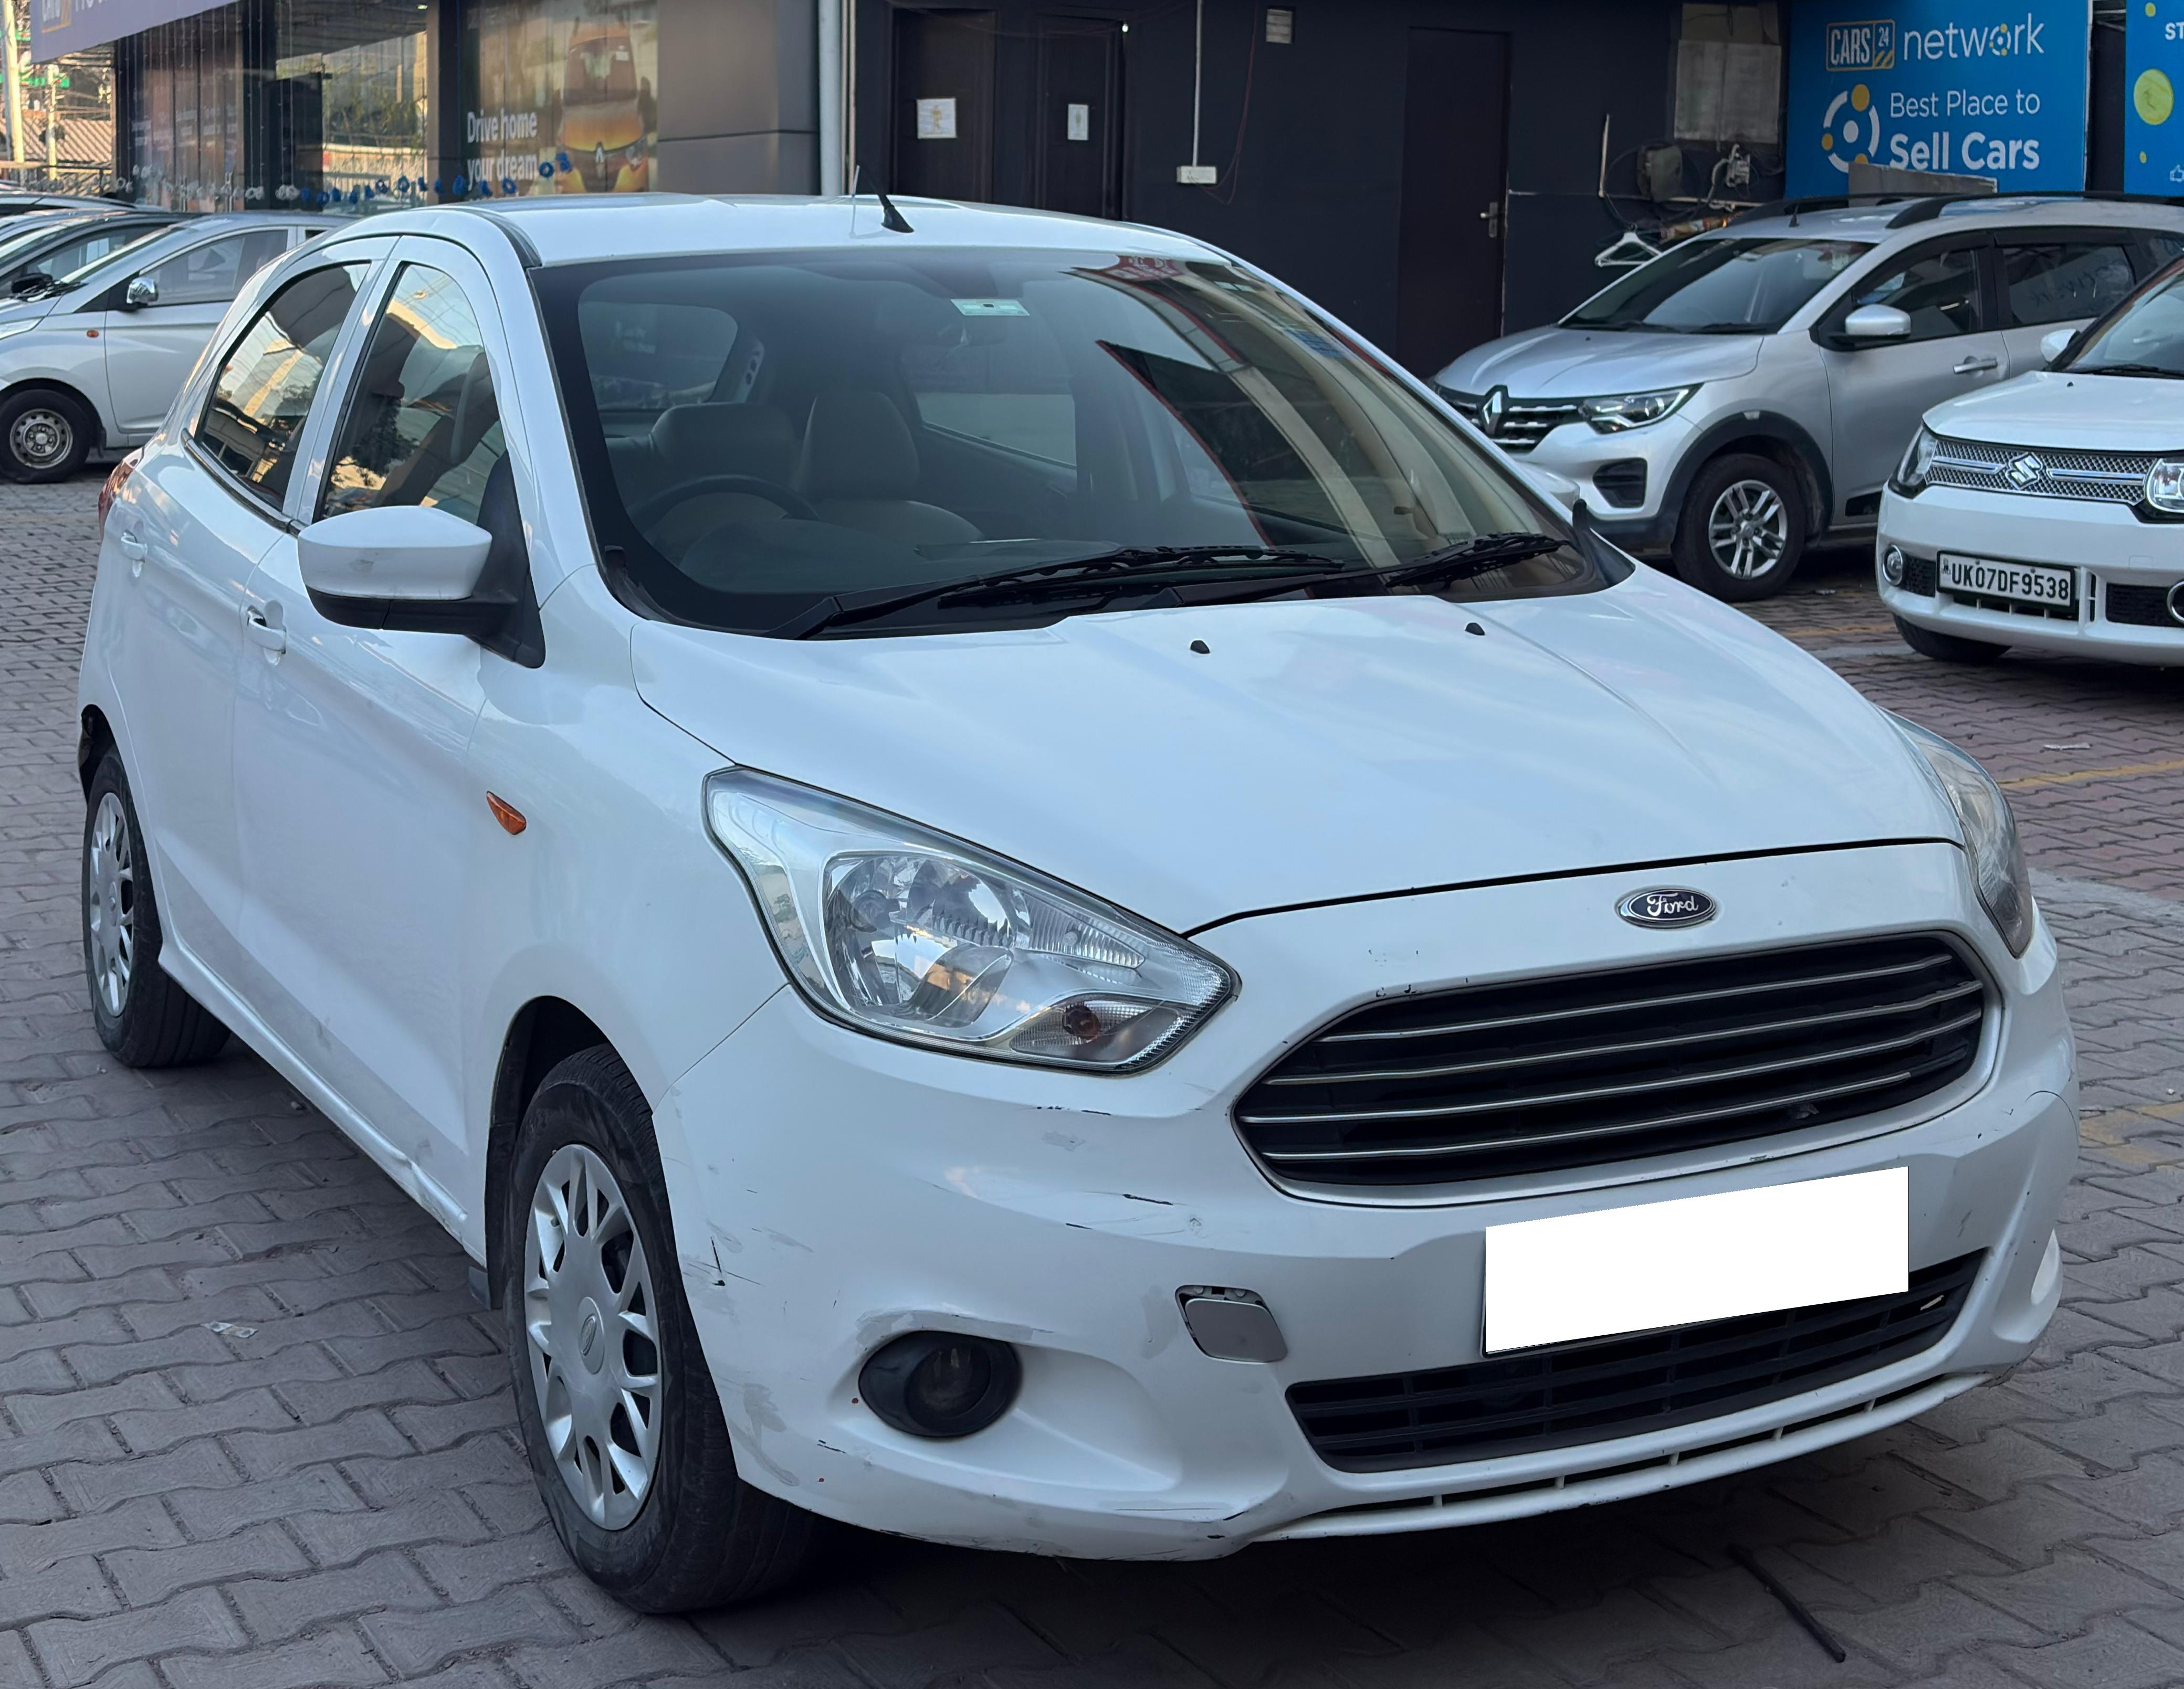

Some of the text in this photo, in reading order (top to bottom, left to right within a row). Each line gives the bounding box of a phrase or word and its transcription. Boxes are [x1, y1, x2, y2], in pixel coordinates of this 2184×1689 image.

[1831, 13, 2045, 65] CARS 24 network
[1890, 89, 2040, 118] Best Place to
[467, 108, 538, 143] Drive home
[1890, 132, 2040, 170] Sell Cars
[467, 149, 537, 191] your dream
[1952, 563, 2069, 600] UK07DF9538
[1646, 893, 1699, 916] Ford
